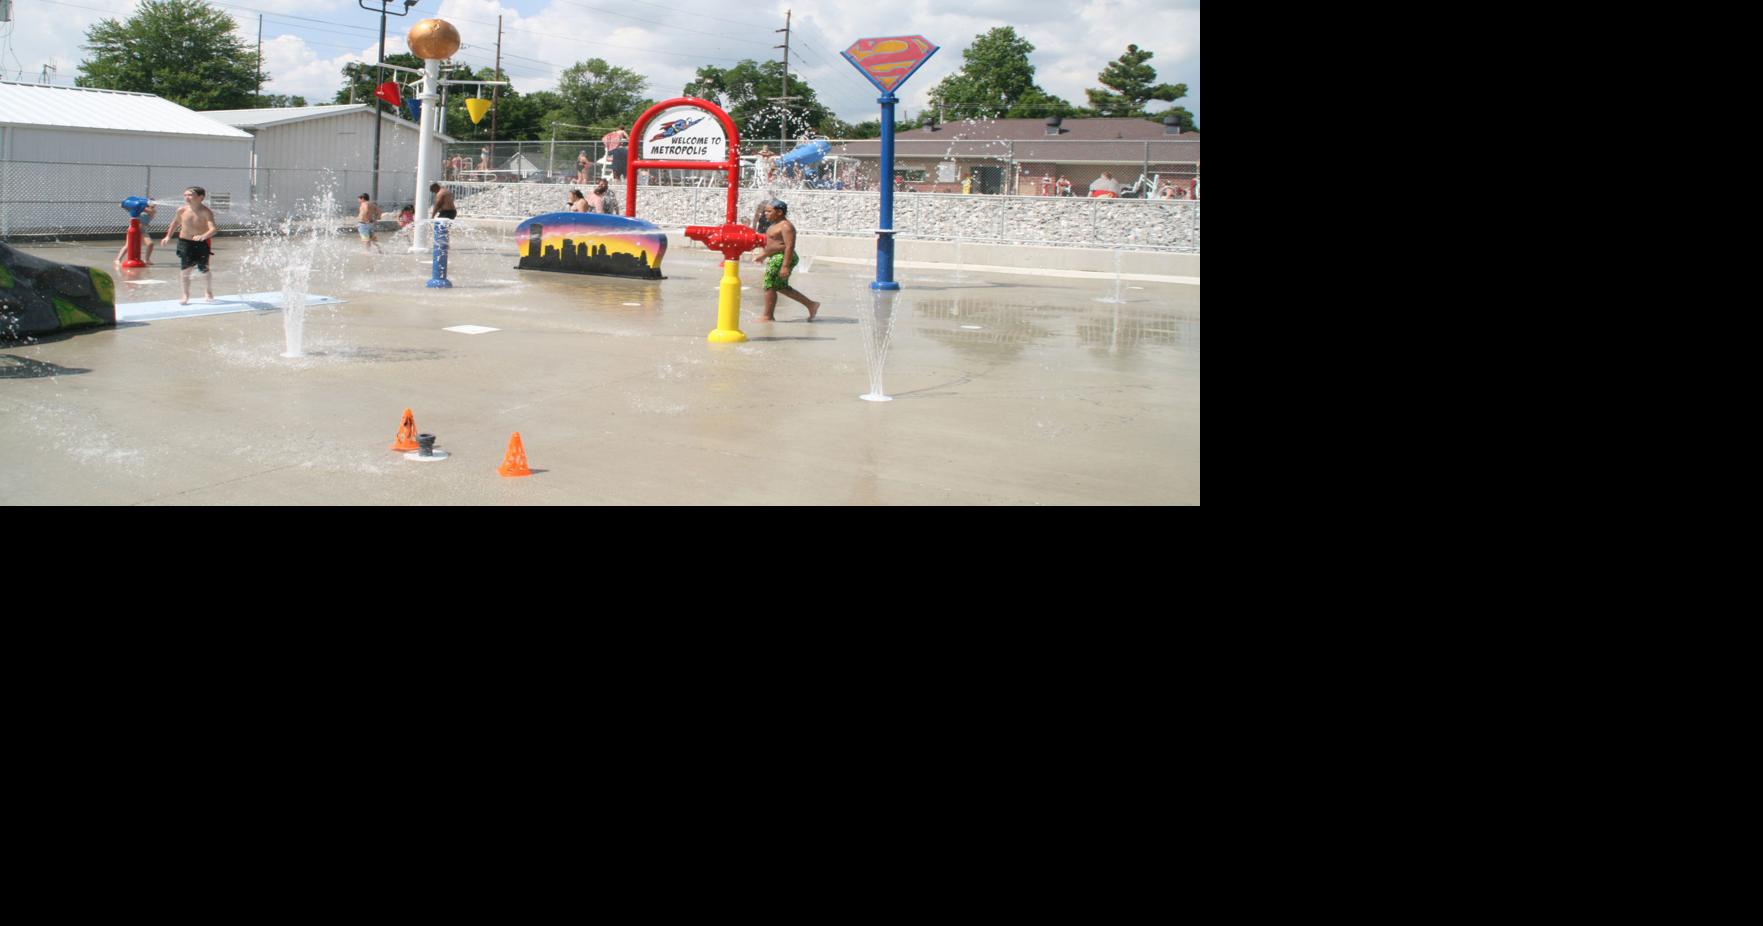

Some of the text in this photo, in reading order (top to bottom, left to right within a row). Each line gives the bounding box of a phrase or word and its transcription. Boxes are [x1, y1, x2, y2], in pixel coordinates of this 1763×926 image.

[671, 136, 721, 145] WELCOME TO
[650, 145, 708, 156] METROPOLIS
